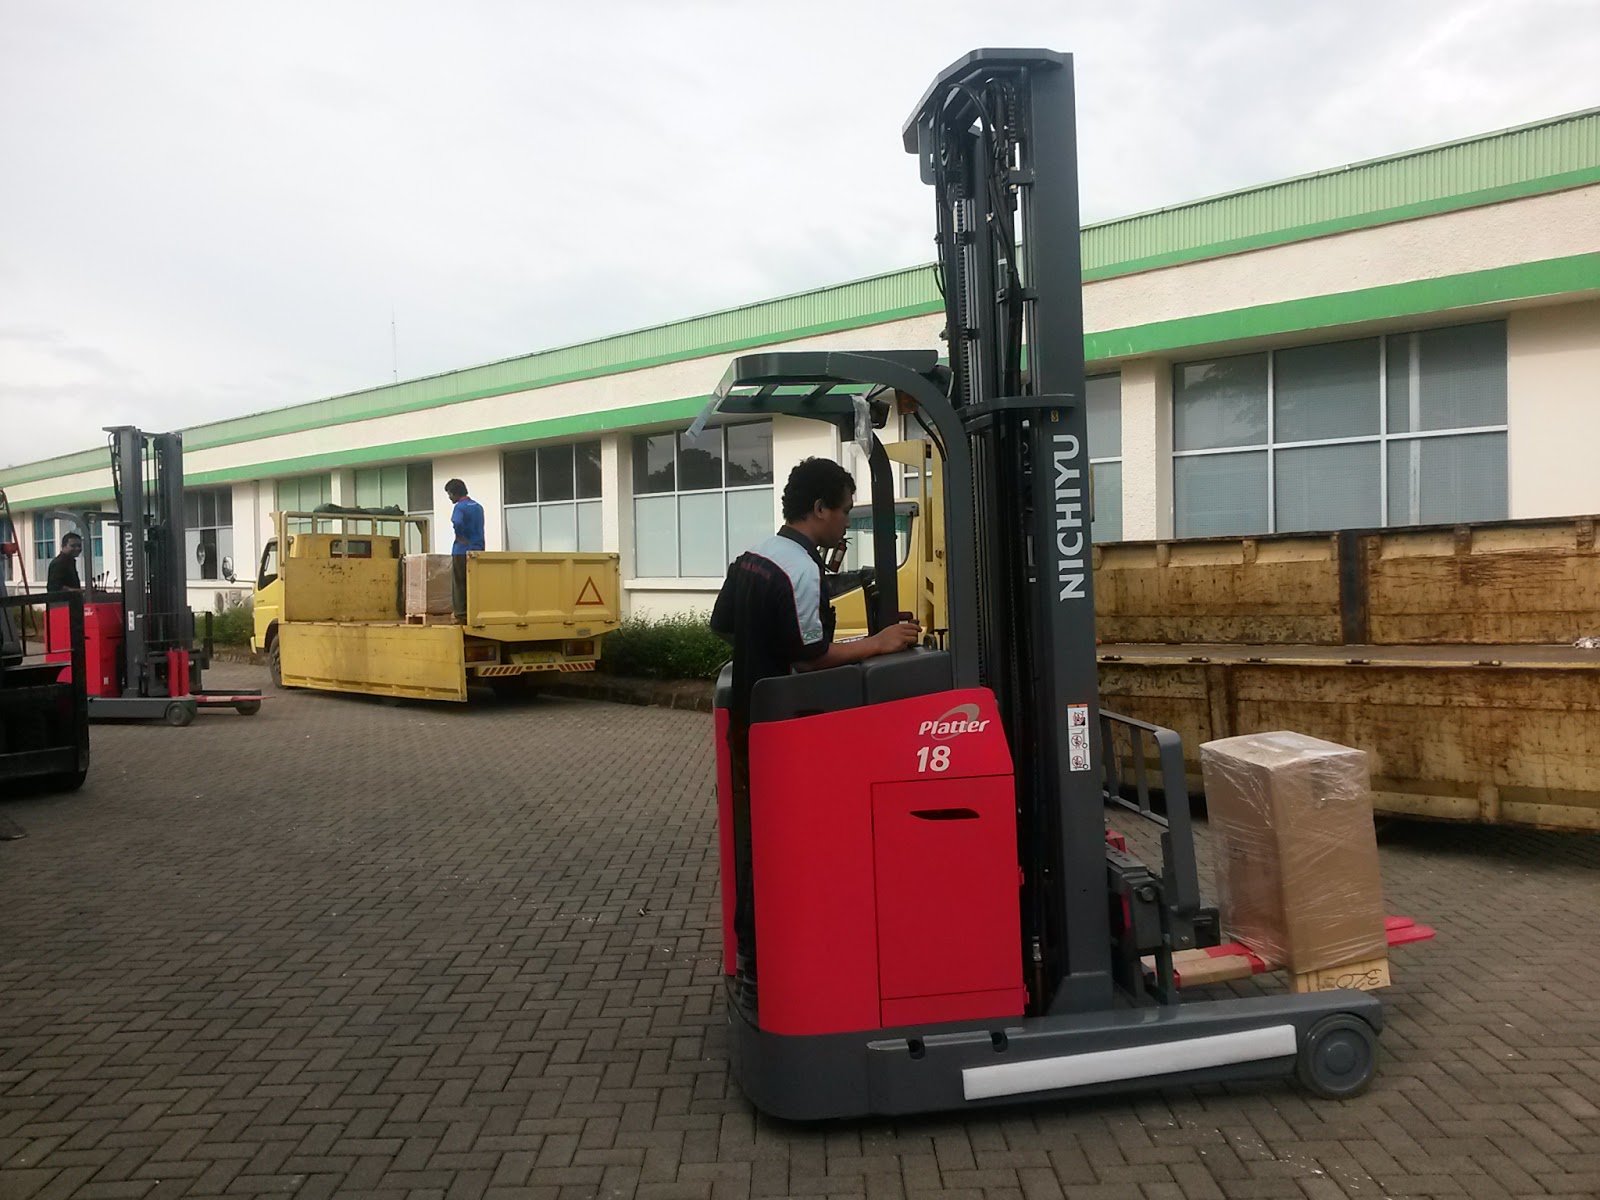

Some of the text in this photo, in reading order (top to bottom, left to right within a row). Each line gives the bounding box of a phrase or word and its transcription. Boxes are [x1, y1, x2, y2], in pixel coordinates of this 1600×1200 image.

[1053, 434, 1086, 602] NICHIYU
[125, 532, 134, 581] NICHIYU
[918, 720, 990, 736] Platter
[916, 745, 951, 773] 18
